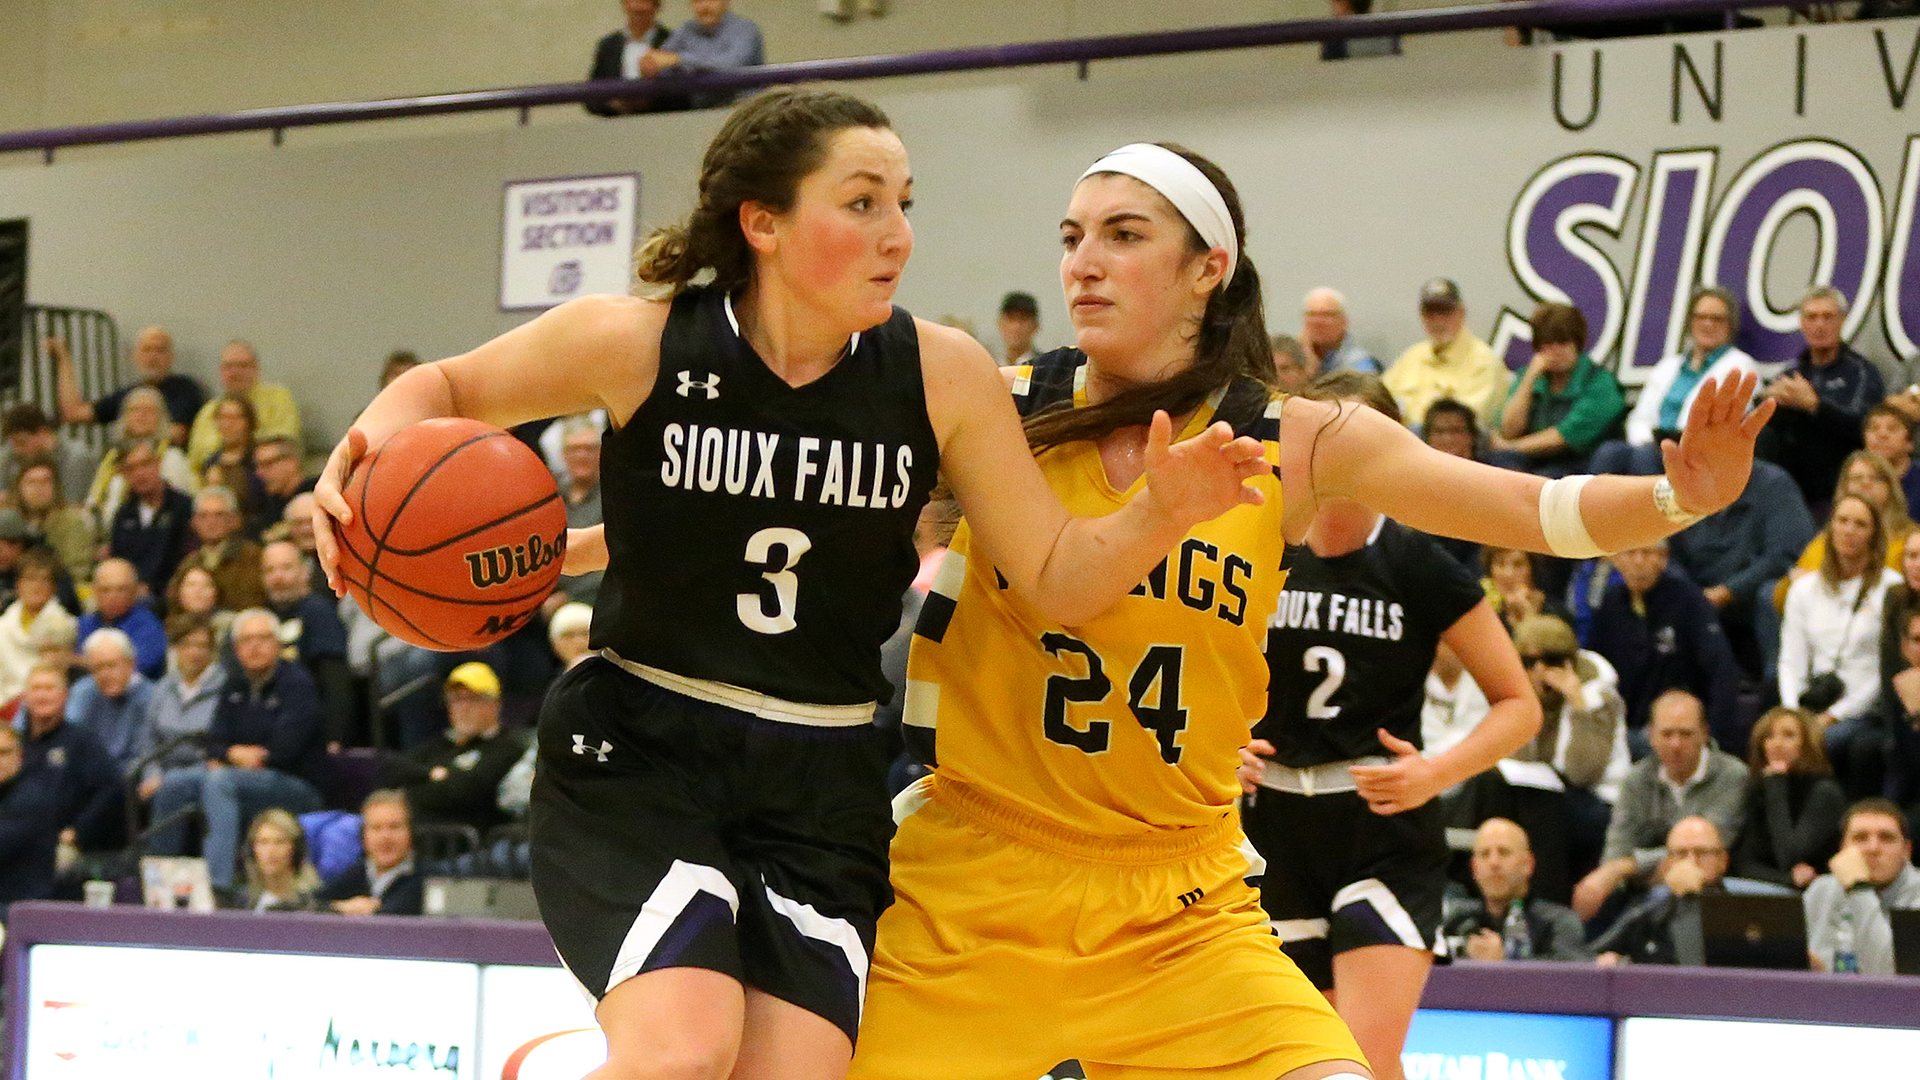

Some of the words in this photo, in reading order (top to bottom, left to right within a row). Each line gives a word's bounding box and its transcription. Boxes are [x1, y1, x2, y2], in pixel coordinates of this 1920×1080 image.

[1552, 28, 1920, 132] UNIV
[521, 221, 615, 251] SECTION
[660, 422, 780, 499] SIOUX
[794, 436, 913, 509] FALLS
[736, 526, 812, 635] 3
[1267, 589, 1323, 629] OUX
[1328, 593, 1405, 641] FALLS
[1039, 629, 1190, 767] 24
[1303, 645, 1346, 720] 2
